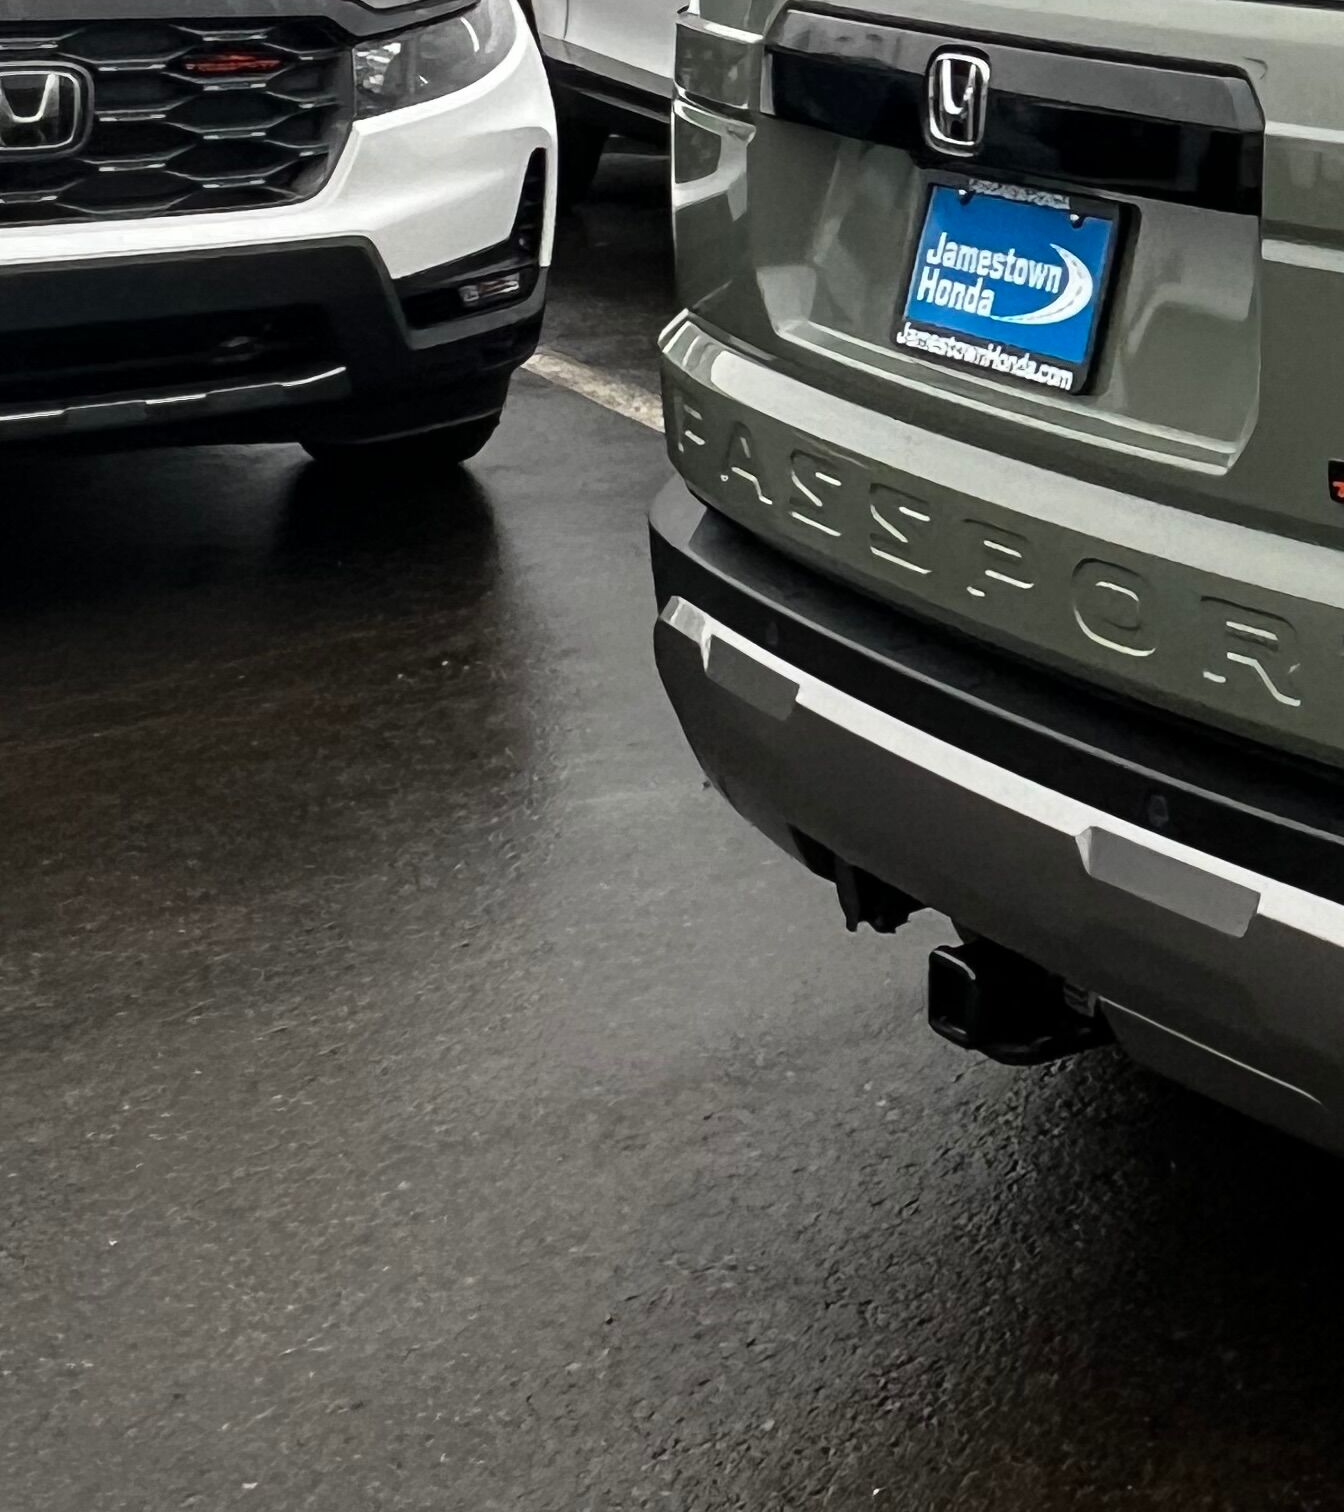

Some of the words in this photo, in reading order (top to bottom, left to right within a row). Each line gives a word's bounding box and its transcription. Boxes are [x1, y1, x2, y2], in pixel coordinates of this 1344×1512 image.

[916, 266, 995, 317] Honda
[926, 232, 1062, 294] Jamestown
[896, 322, 1074, 390] JamestownHonda.com
